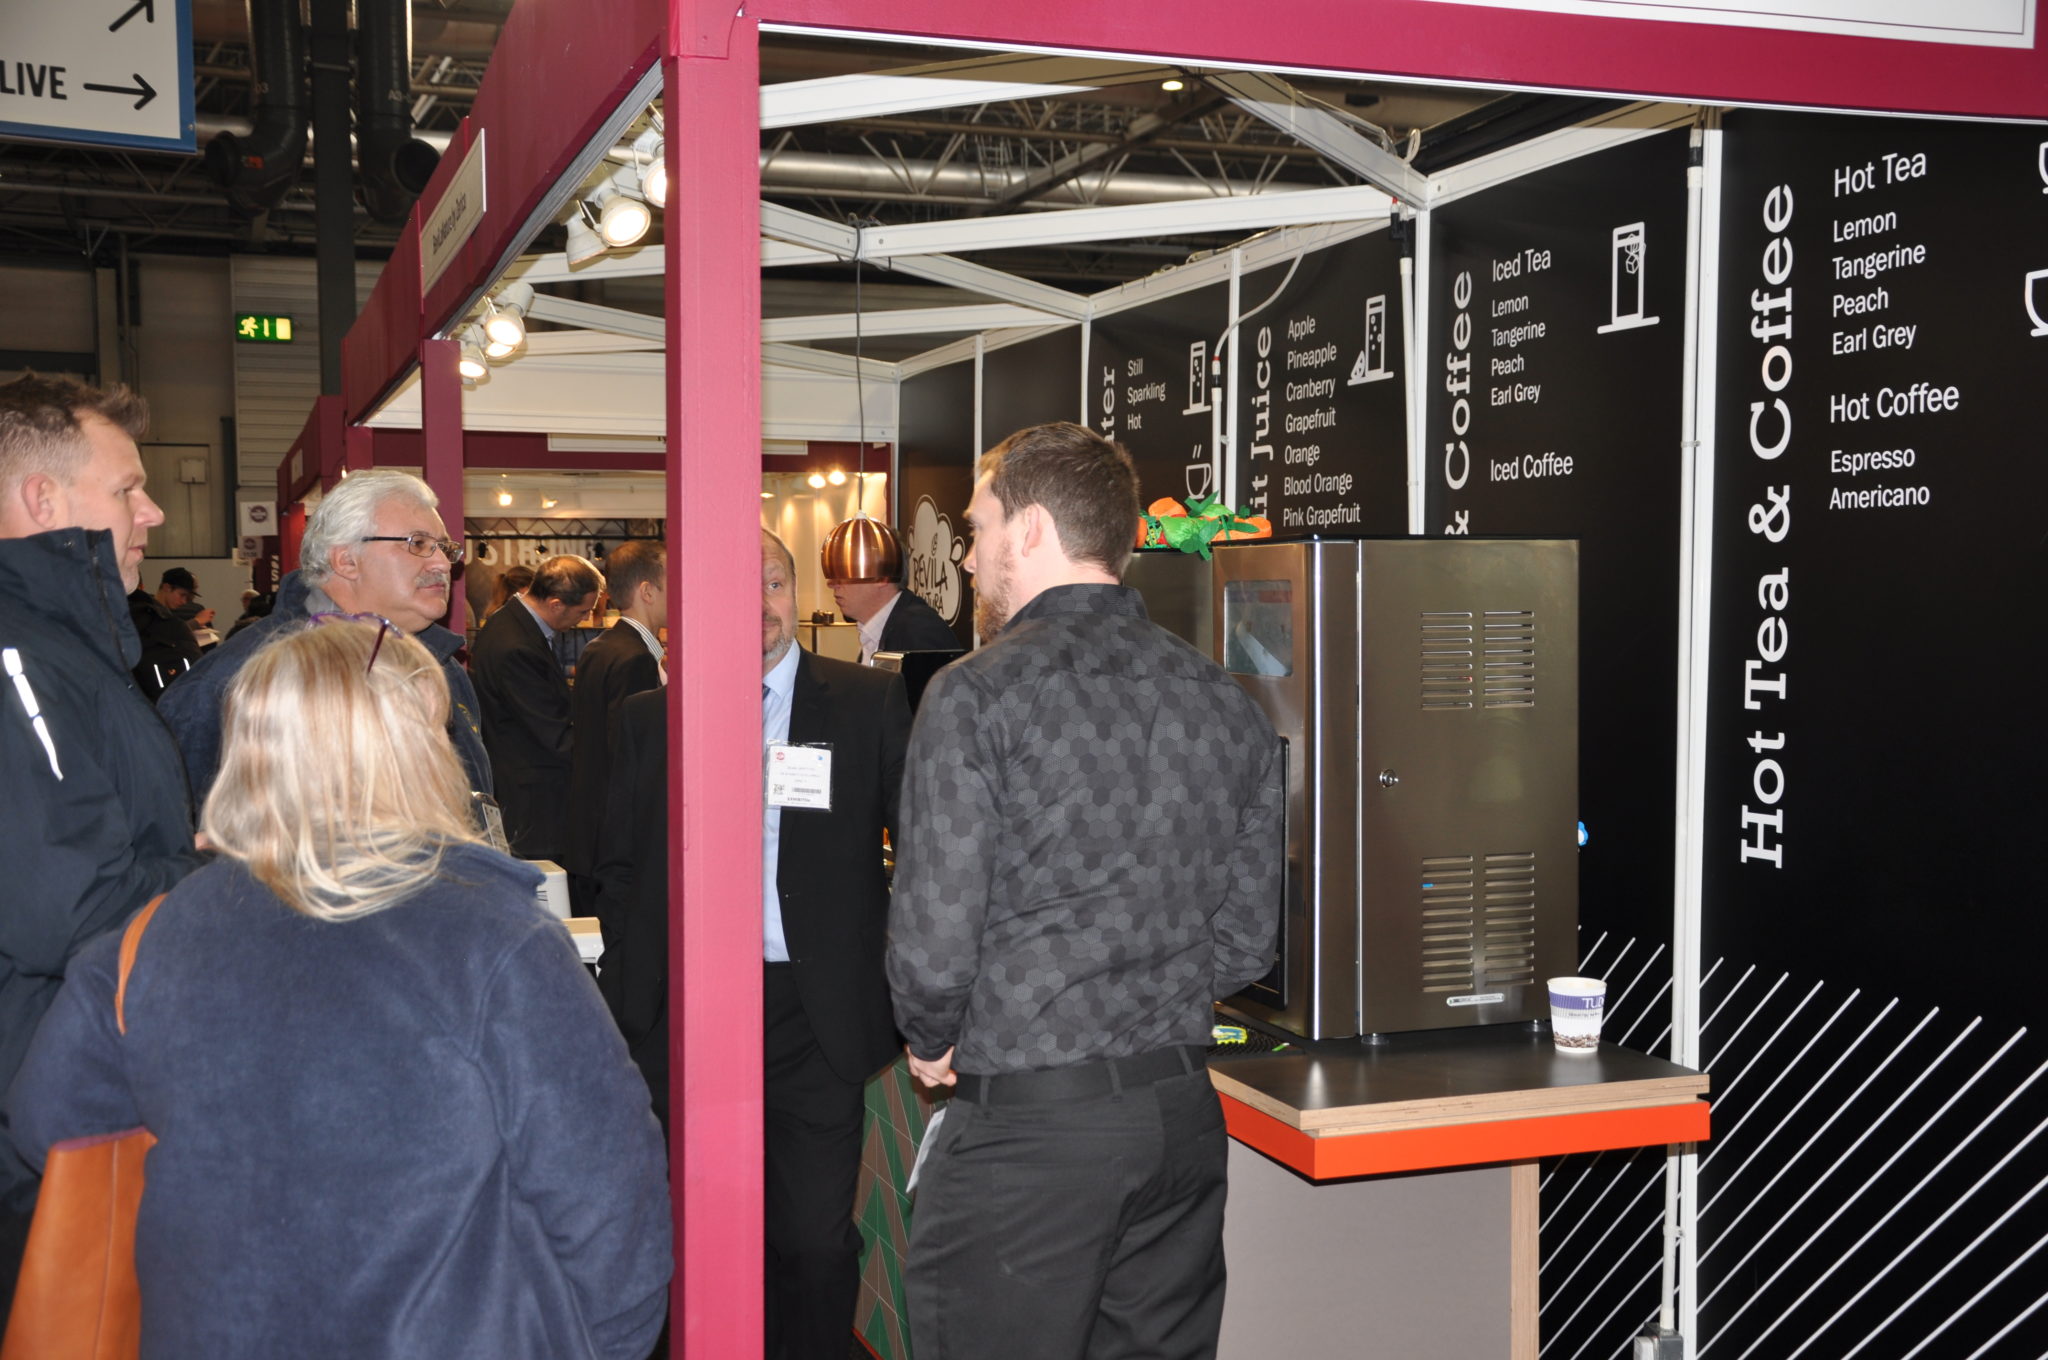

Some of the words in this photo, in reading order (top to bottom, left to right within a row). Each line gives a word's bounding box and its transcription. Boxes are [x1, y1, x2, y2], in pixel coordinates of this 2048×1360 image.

[0, 60, 67, 99] LIVE
[1835, 162, 1875, 197] Hot
[1882, 153, 1926, 184] Tea
[1834, 212, 1899, 242] Lemon
[1493, 253, 1520, 282] Iced
[1525, 249, 1550, 272] Tea
[1832, 244, 1925, 279] Tangerine
[1492, 296, 1528, 317] Lemon
[1833, 287, 1888, 317] Peach
[1288, 316, 1315, 341] Apple
[1492, 321, 1545, 347] Tangerine
[1750, 184, 1793, 460] Coffee
[1833, 328, 1866, 355] Earl
[1873, 325, 1916, 349] Grey
[1128, 359, 1142, 376] Still
[1288, 342, 1336, 370] Pineapple
[1492, 354, 1524, 376] Peach
[1128, 383, 1165, 405] Sparkling
[1251, 327, 1273, 460] Juice
[1287, 379, 1335, 401] Cranberry
[1445, 272, 1472, 489] Coffee
[1491, 386, 1511, 406] Earl
[1514, 383, 1540, 403] Grey
[1831, 393, 1870, 423] Hot
[1877, 382, 1959, 417] Coffee
[1128, 414, 1141, 429] Hot
[1286, 407, 1336, 434] Grapefruit
[1285, 445, 1320, 466] Orange
[1491, 456, 1518, 481] Iced
[1523, 452, 1573, 478] Coffee
[1831, 449, 1915, 476] Espresso
[1284, 475, 1311, 495] Blood
[1314, 473, 1352, 495] Orange
[1830, 484, 1930, 509] Americano
[1284, 508, 1303, 526] Pink
[1307, 503, 1360, 528] Grapefruit
[1748, 485, 1790, 542] &
[1745, 567, 1788, 710] Tea
[1741, 731, 1785, 868] Hot
